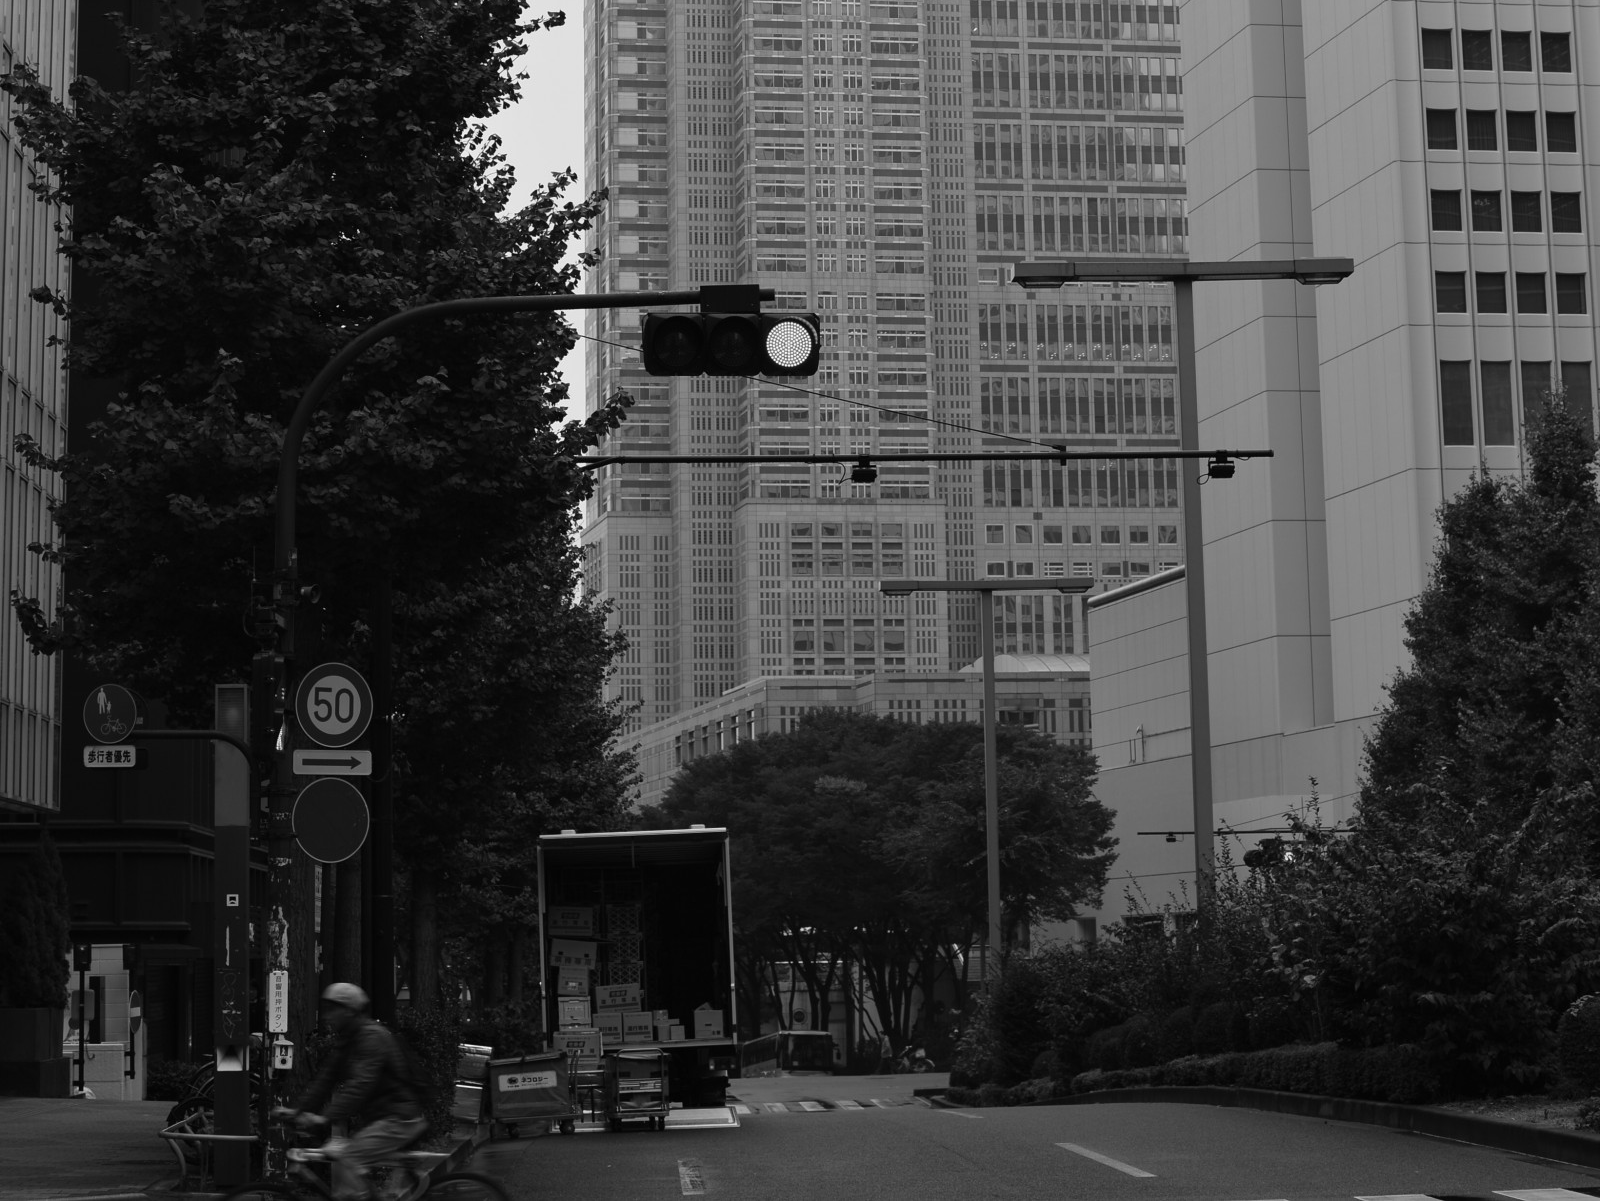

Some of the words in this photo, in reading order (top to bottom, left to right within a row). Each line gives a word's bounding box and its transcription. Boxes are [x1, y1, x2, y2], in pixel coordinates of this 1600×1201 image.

[314, 686, 354, 723] 50
[88, 750, 131, 763] 歩行者優先
